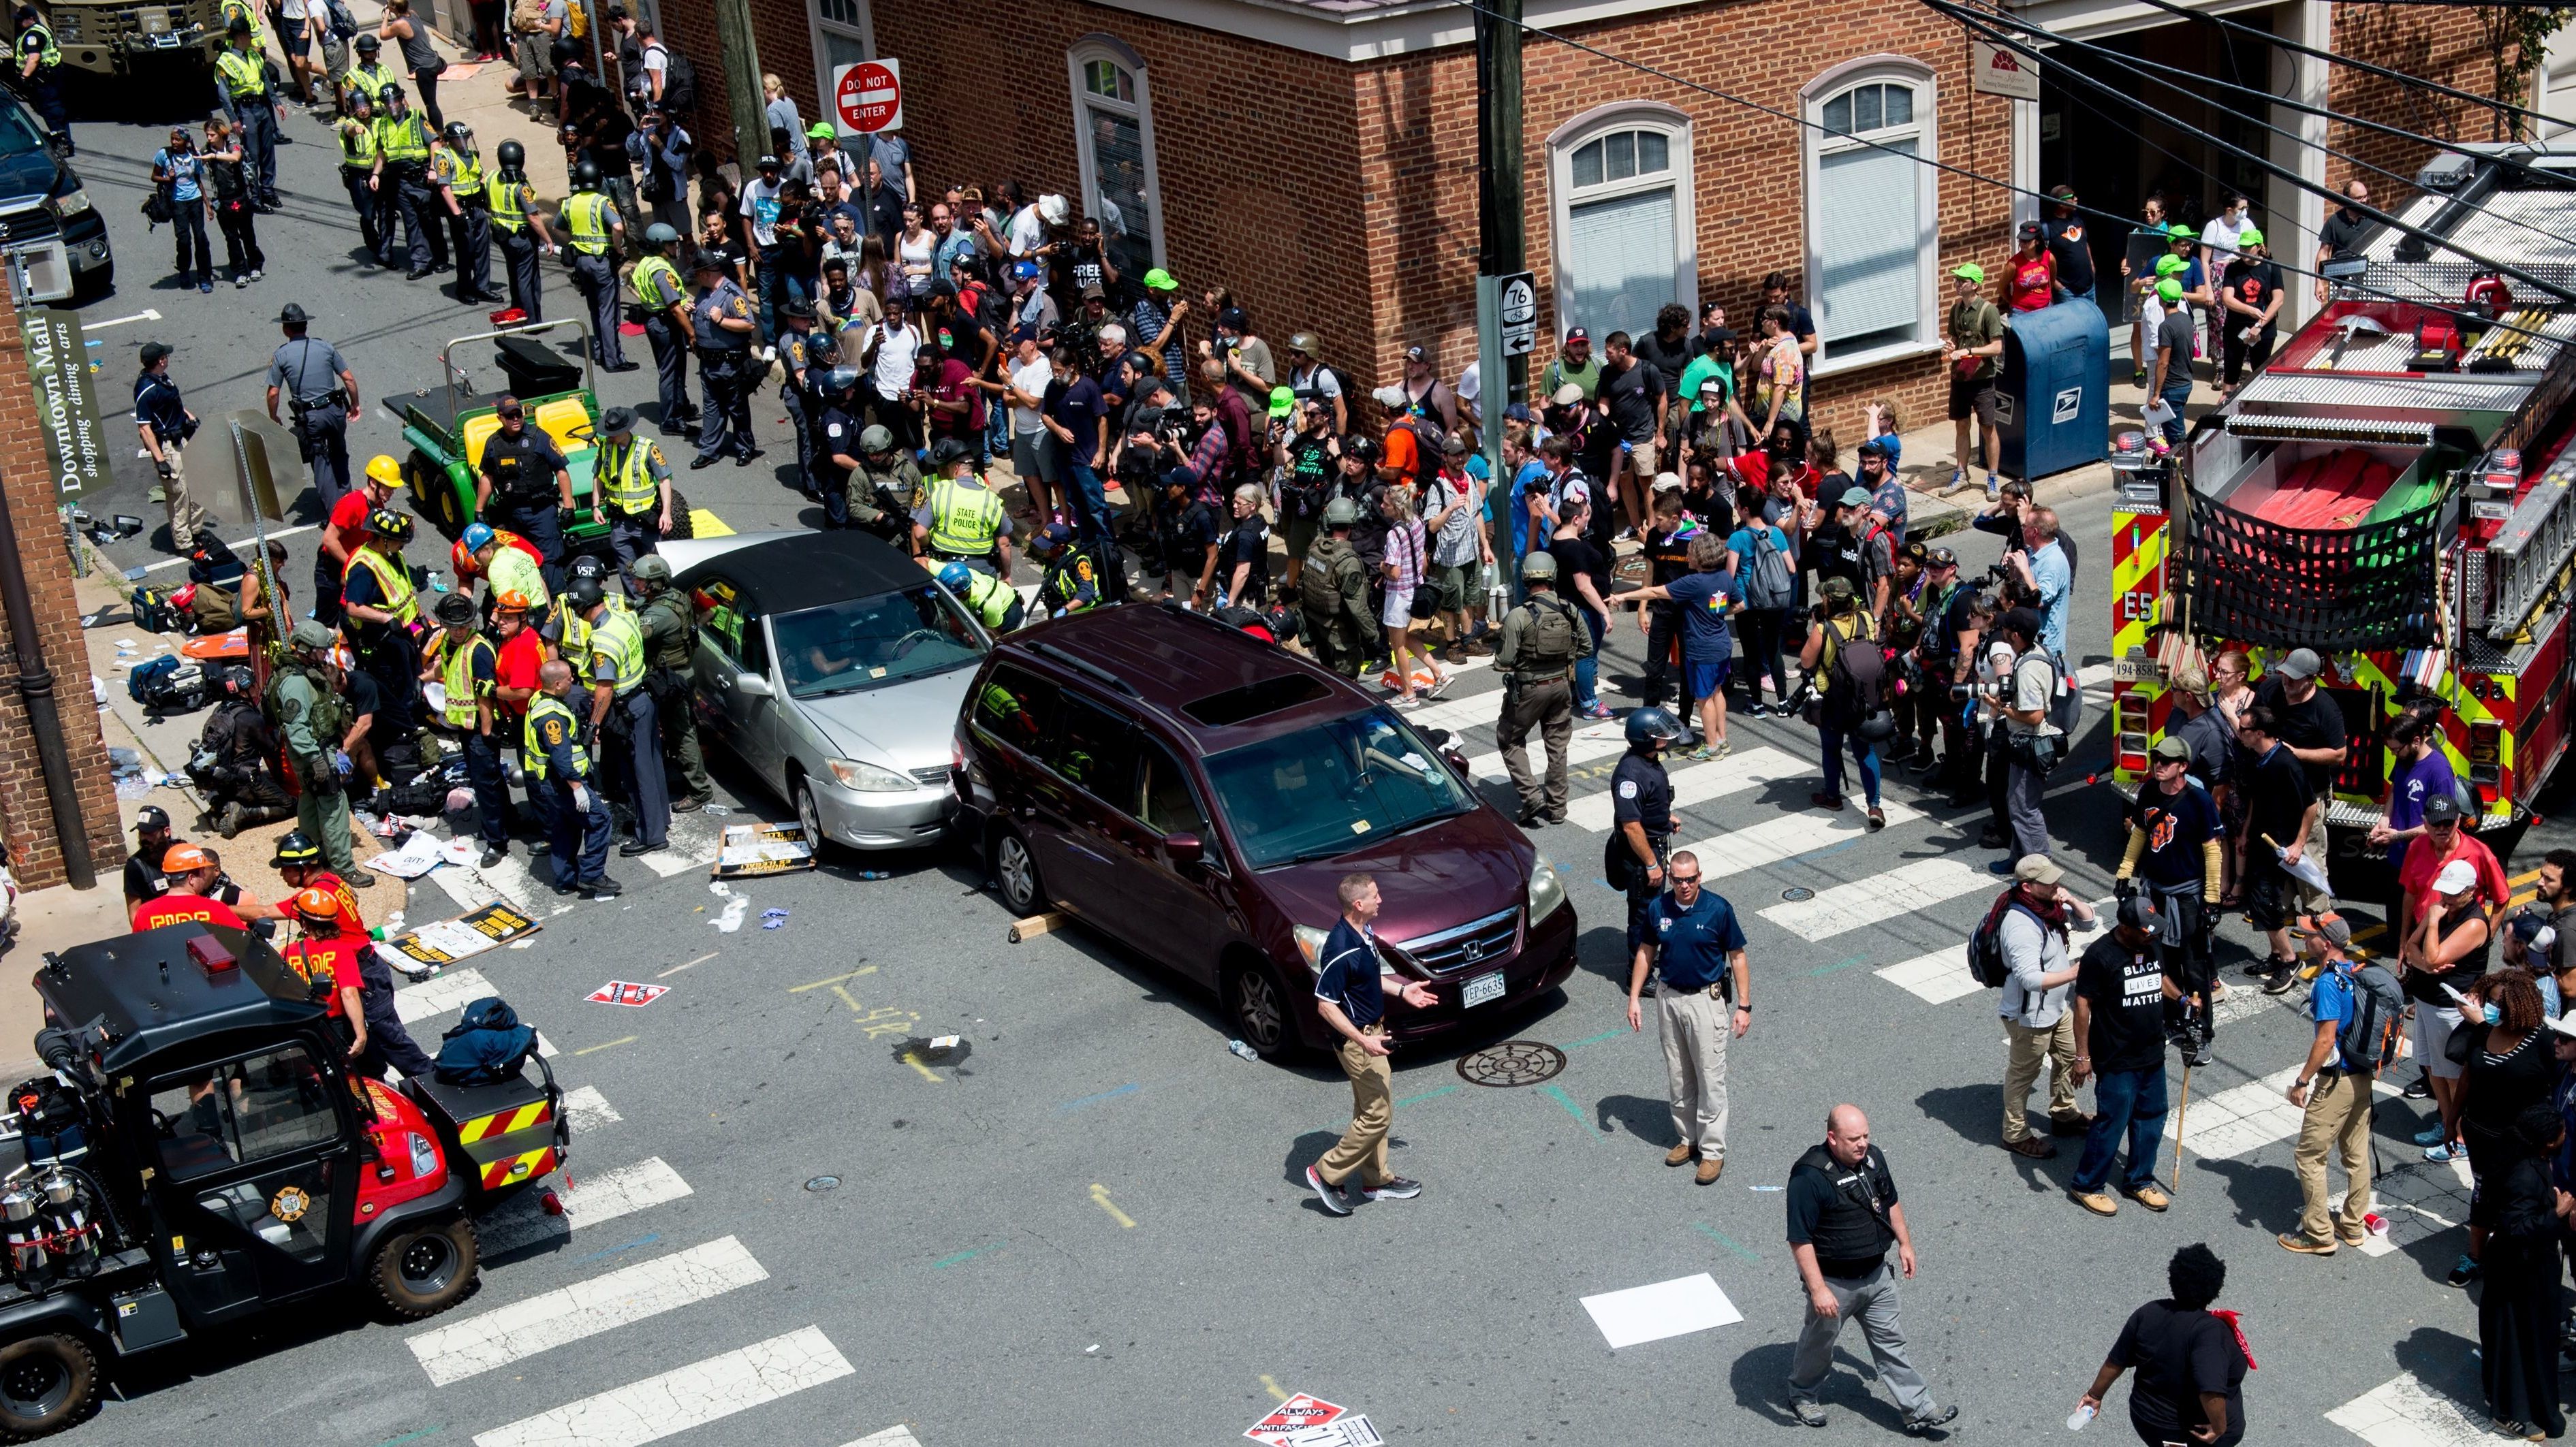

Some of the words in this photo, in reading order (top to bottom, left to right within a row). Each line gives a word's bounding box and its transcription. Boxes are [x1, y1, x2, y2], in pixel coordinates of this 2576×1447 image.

[847, 80, 860, 91] DO
[866, 75, 887, 87] NOT
[853, 106, 886, 120] ENTER
[957, 253, 969, 263] TV
[1509, 289, 1527, 306] 76
[26, 317, 57, 370] Mall
[57, 322, 71, 349] arts
[65, 362, 83, 406] dining
[44, 372, 82, 494] Downtown
[76, 418, 97, 478] shopping
[956, 507, 975, 519] STATE
[954, 518, 976, 529] POLICE
[577, 565, 596, 576] VSP
[2123, 590, 2153, 622] E5
[2123, 960, 2161, 976] BLACK
[1464, 978, 1503, 1001] VEP-6635
[2129, 977, 2160, 991] LIVES
[1278, 1408, 1325, 1416] ALWAYS
